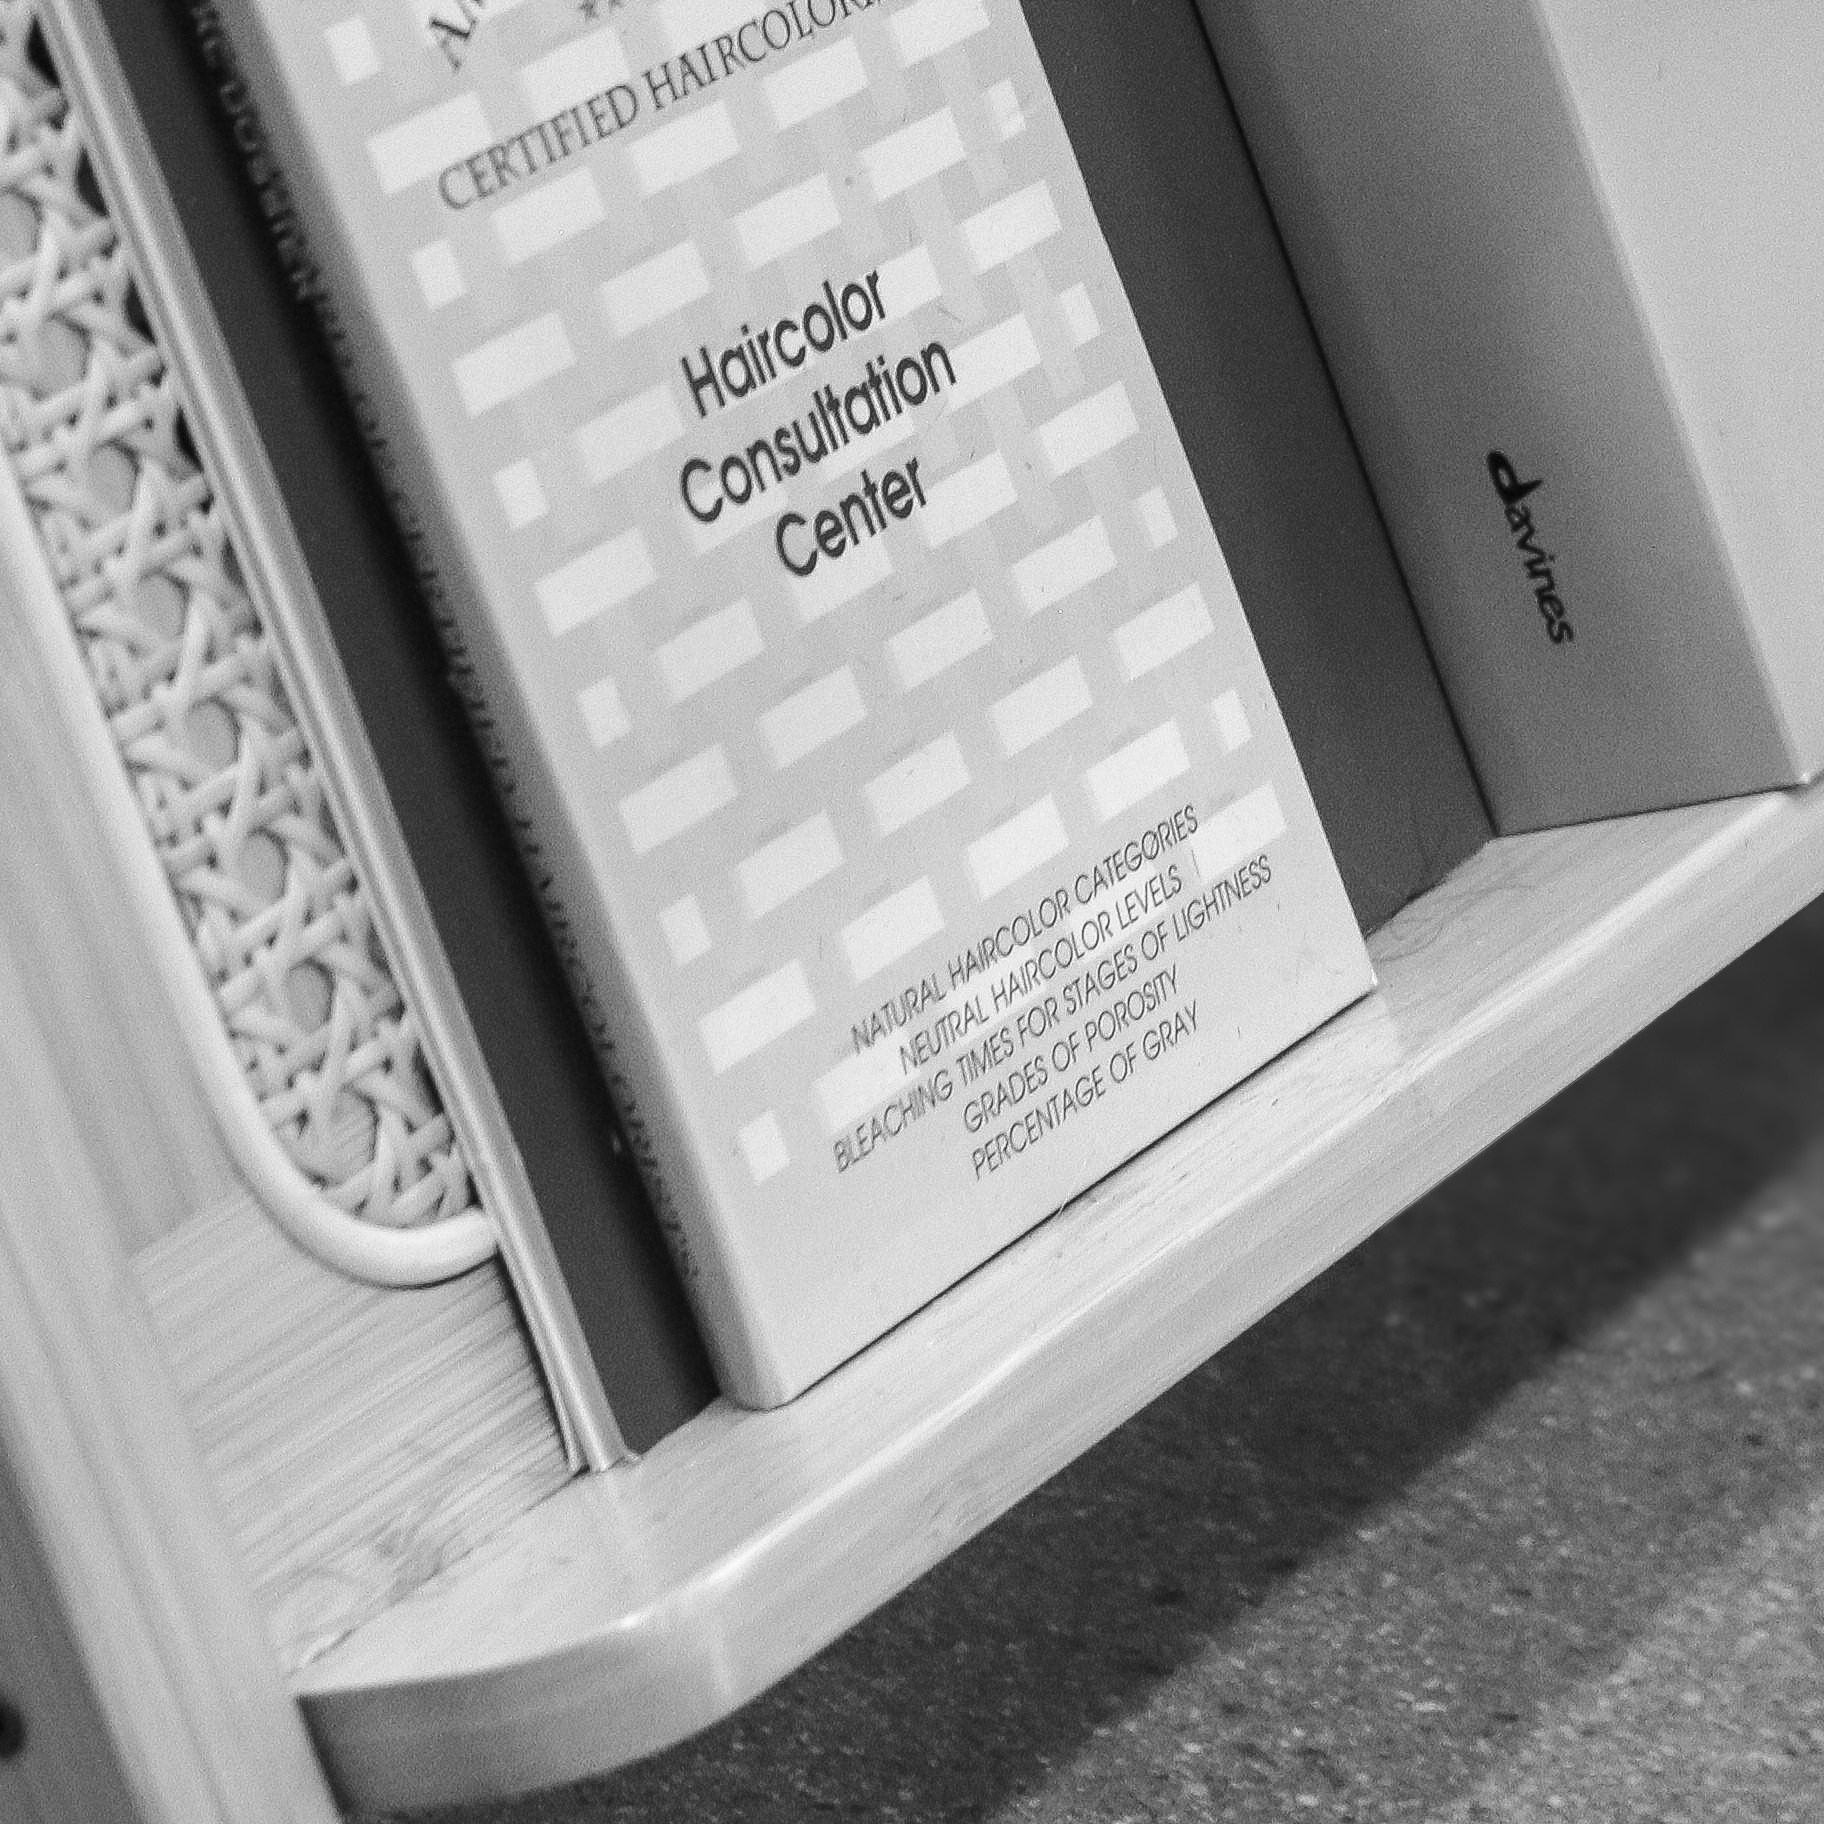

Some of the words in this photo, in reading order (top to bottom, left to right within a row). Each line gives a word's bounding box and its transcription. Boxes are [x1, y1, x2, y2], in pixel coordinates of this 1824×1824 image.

[437, 83, 640, 211] CERTIFIED
[680, 341, 956, 523] Consultation
[681, 270, 886, 417] Haircolor
[776, 457, 926, 577] Center
[1487, 451, 1574, 643] davines
[833, 1069, 953, 1173] BLEACHING
[956, 1027, 1014, 1086] TIMES
[1017, 996, 1060, 1047] FOR
[1063, 944, 1137, 1015] STAGES
[1141, 920, 1168, 961] OF
[1172, 854, 1272, 942] LIGHTNESS
[851, 973, 946, 1054] NATURAL
[948, 889, 1071, 990] HAIRCOLOR
[1075, 805, 1198, 904] CATEGORIES
[899, 995, 989, 1075] NEUTRAL
[991, 911, 1113, 1013] HAIRCOLOR
[1116, 864, 1182, 930] LEVELS
[964, 1055, 1048, 1133] GRADES
[1052, 1031, 1080, 1072] OF
[1085, 963, 1177, 1052] POROSITY
[972, 1063, 1106, 1181] PERCENTAGE
[1110, 1041, 1135, 1084] OF
[1142, 999, 1197, 1061] GRAY
